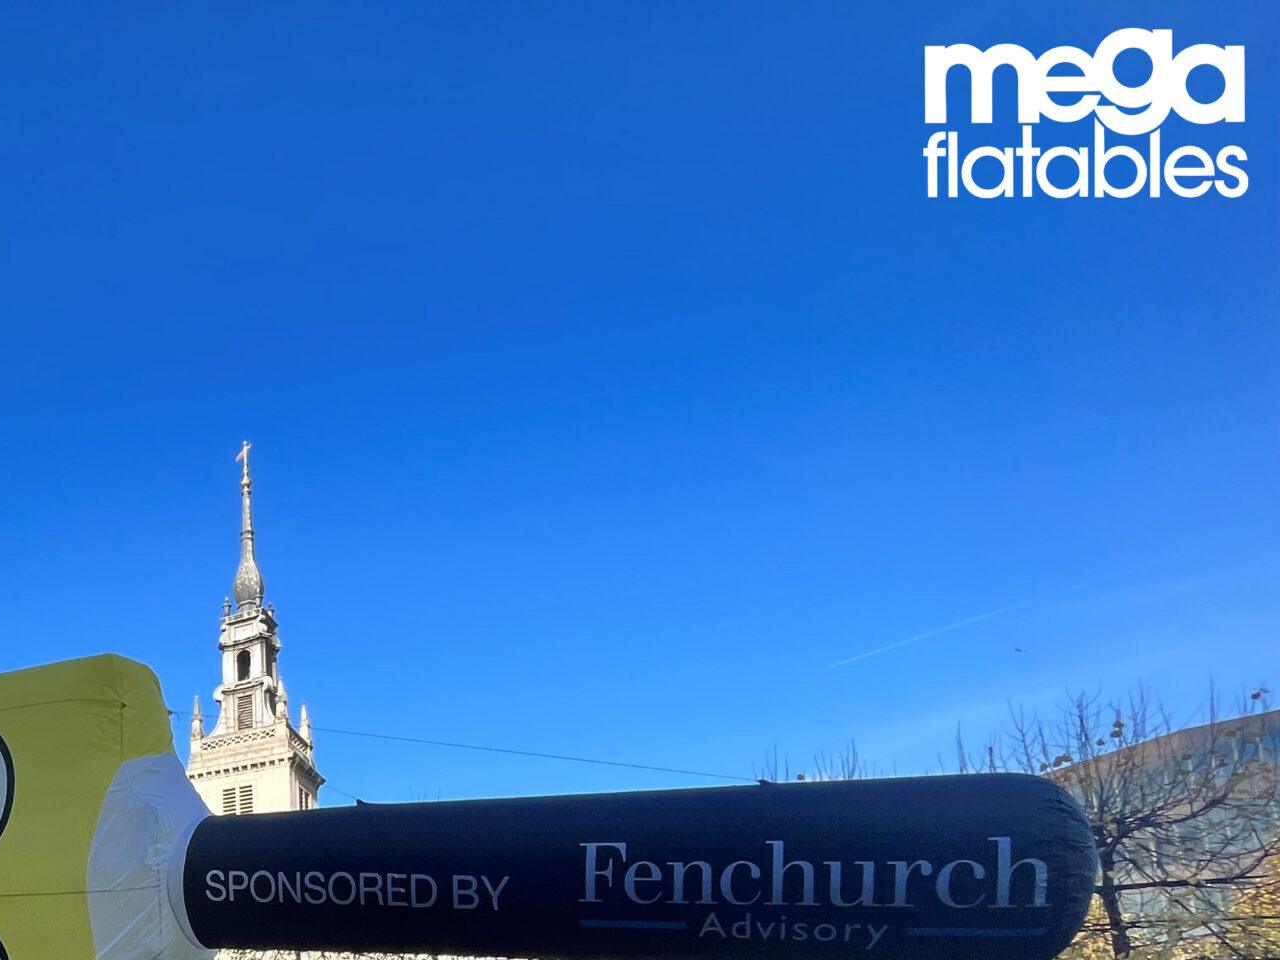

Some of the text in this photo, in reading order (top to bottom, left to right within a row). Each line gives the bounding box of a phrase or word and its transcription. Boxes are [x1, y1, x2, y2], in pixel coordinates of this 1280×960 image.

[205, 869, 510, 911] SPONSORED BY
[578, 836, 1053, 910] Fenchurch
[698, 912, 889, 950] Advisory
